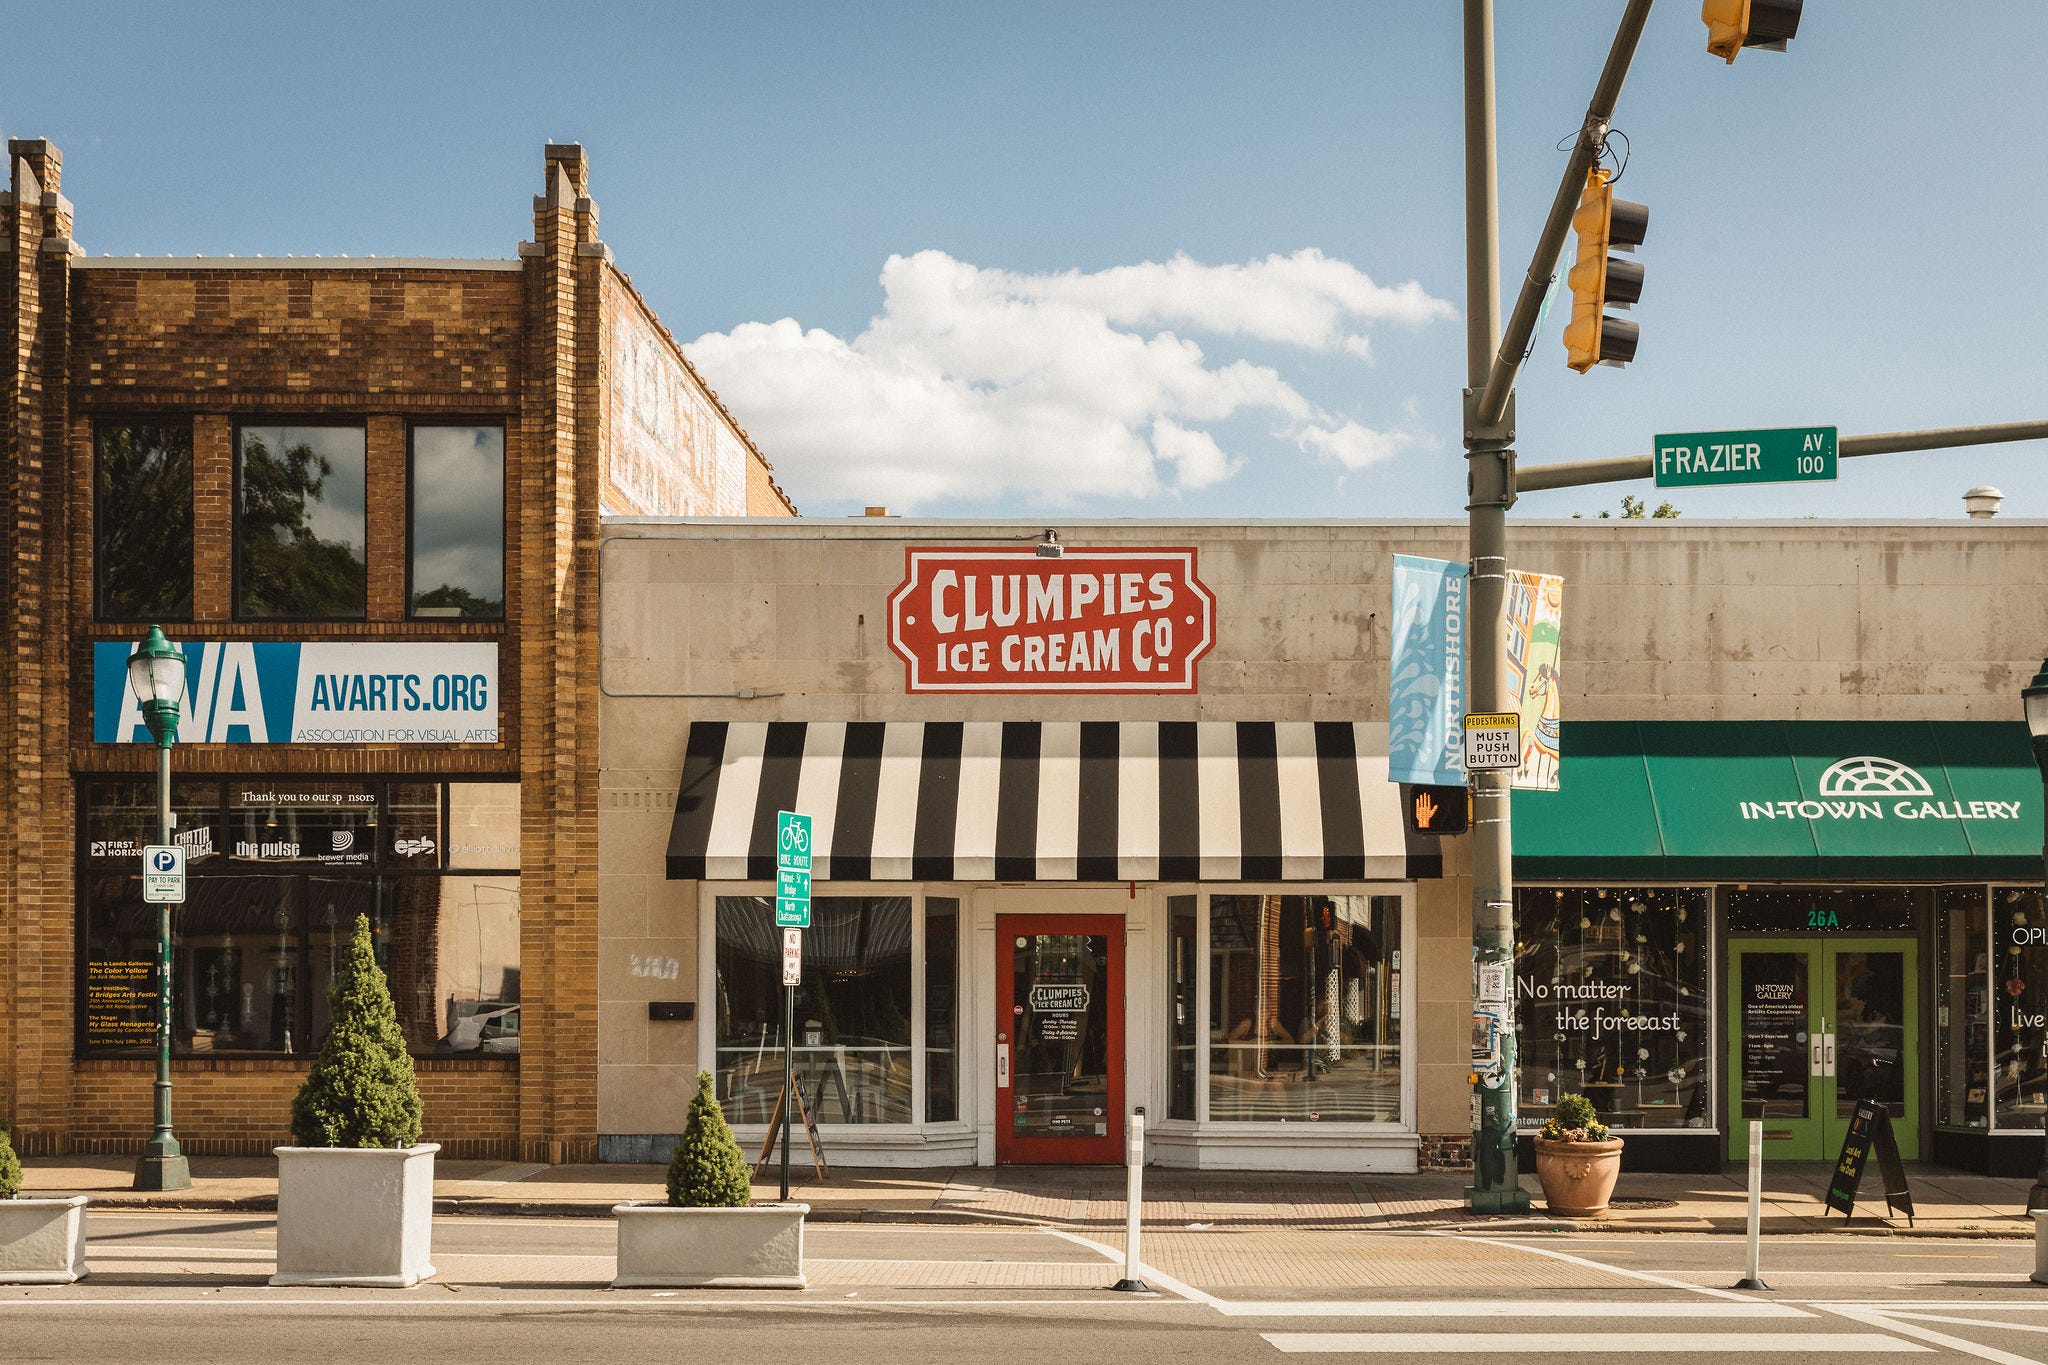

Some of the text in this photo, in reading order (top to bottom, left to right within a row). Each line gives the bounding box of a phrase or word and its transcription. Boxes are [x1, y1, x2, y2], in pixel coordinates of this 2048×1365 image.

[1802, 433, 1823, 452] AV
[1660, 443, 1761, 475] FRAZIER
[1796, 456, 1825, 474] 100
[931, 569, 1174, 634] CLUMPIES
[936, 641, 991, 672] ICE
[1001, 628, 1121, 672] CREAM
[1445, 575, 1463, 772] NORTHSHORE
[310, 674, 488, 712] AVARTS.ORG
[1466, 715, 1516, 727] PEDESTRIANS
[296, 729, 497, 742] ASSOCIATION FOR VISUAL ARTS
[1475, 731, 1510, 742] MUST
[1476, 742, 1510, 753] PUSH
[1469, 753, 1517, 764] BUTTON
[241, 791, 276, 802] Thank
[278, 793, 297, 804] you
[299, 792, 310, 802] to
[312, 794, 330, 802] our
[1739, 800, 2022, 820] IN-TOWN GALLERY
[174, 826, 210, 848] CHATTA
[107, 841, 134, 849] FIRST
[183, 840, 213, 860] OOGA
[236, 841, 300, 858] the pulse
[394, 835, 436, 858] epb
[107, 849, 143, 857] HORIZO
[317, 853, 369, 861] brewer media
[780, 854, 809, 867] BIKE ROUTE
[159, 852, 173, 871] P
[148, 876, 181, 884] PAY TO PARK
[784, 884, 797, 898] Bridge
[784, 900, 796, 912] North
[778, 910, 802, 925] Chattanooga
[1807, 910, 1839, 927] 26A
[1037, 988, 1082, 1001] CLUMPIES
[1516, 975, 1548, 999] No
[1553, 980, 1631, 999] matter
[1755, 984, 1794, 992] IN-TOWN
[1756, 991, 1792, 1000] GALLERY
[1050, 999, 1072, 1008] CREAM
[1555, 1006, 1680, 1041] the forecast
[2011, 1005, 2045, 1027] live
